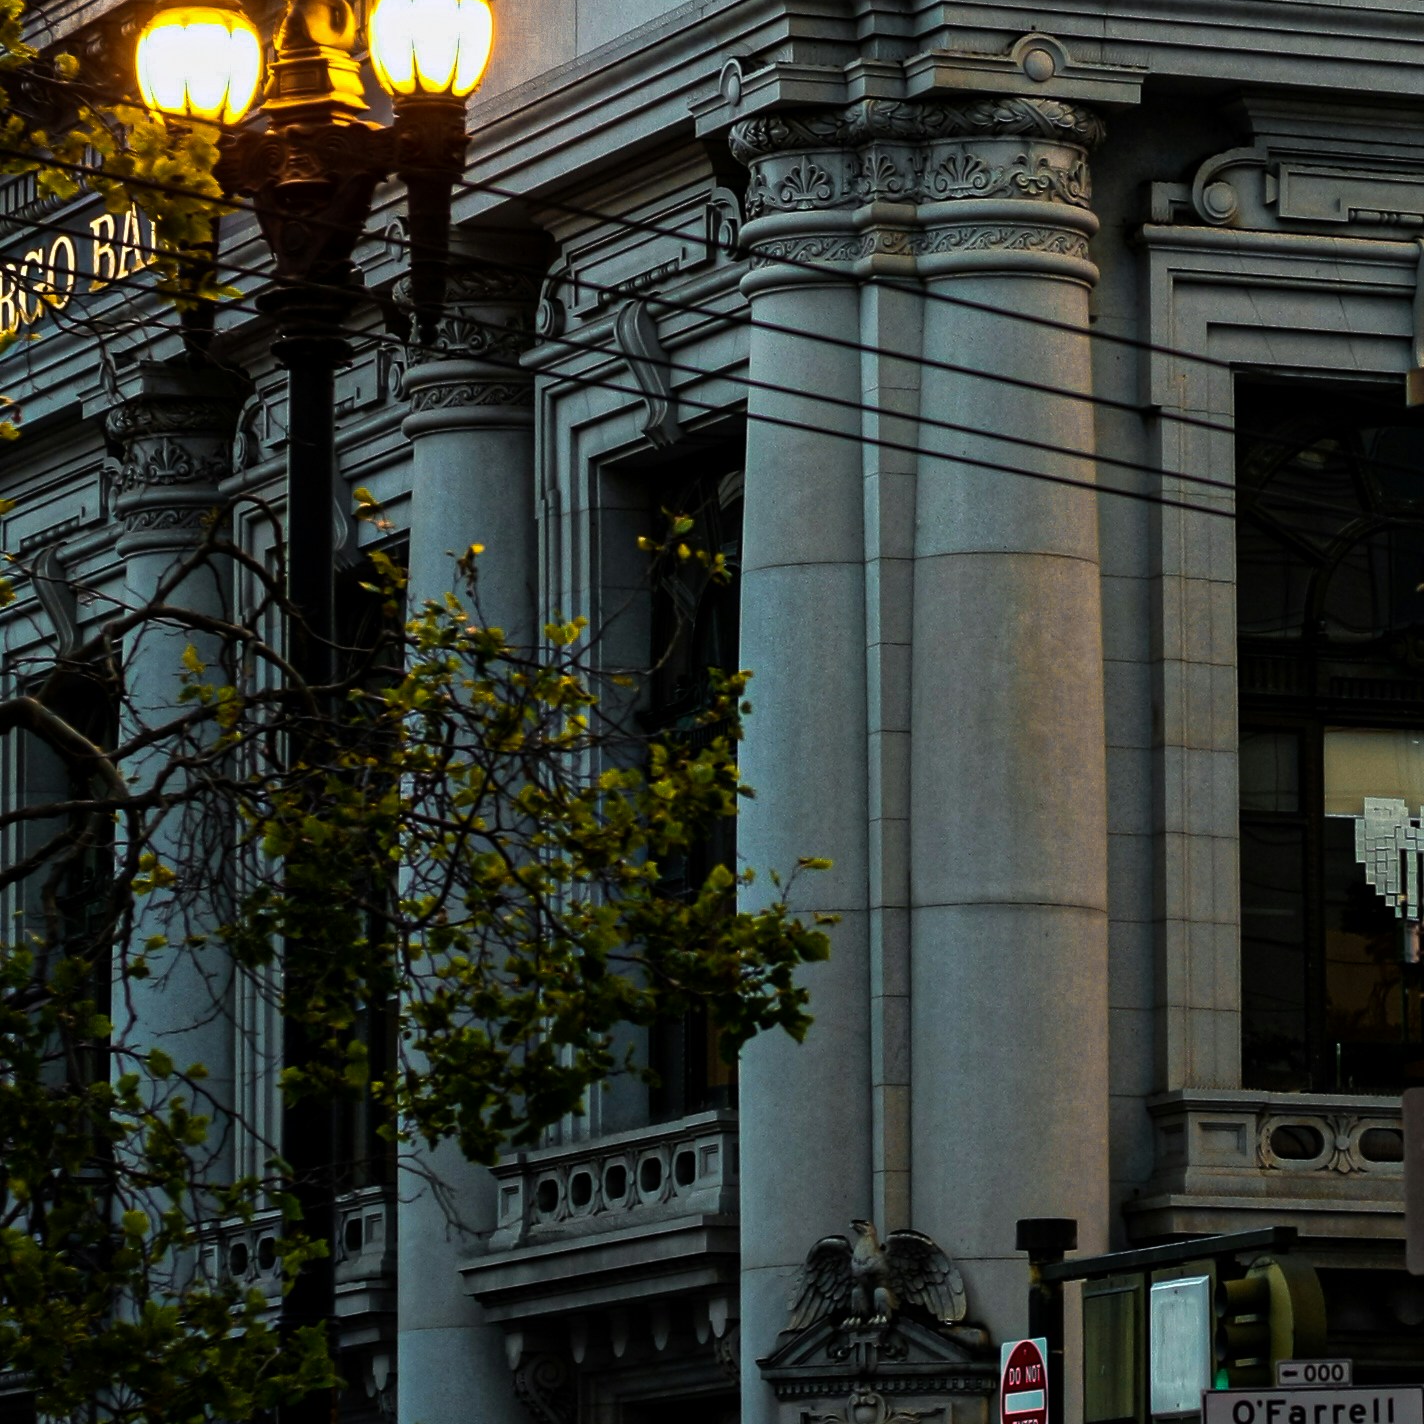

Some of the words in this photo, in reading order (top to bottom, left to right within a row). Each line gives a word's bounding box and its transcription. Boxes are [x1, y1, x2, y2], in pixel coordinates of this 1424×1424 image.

[0, 236, 76, 334] RGO
[88, 201, 158, 292] BA
[1008, 1365, 1021, 1386] DO
[1025, 1363, 1042, 1383] NOT
[1303, 1363, 1345, 1382] 000
